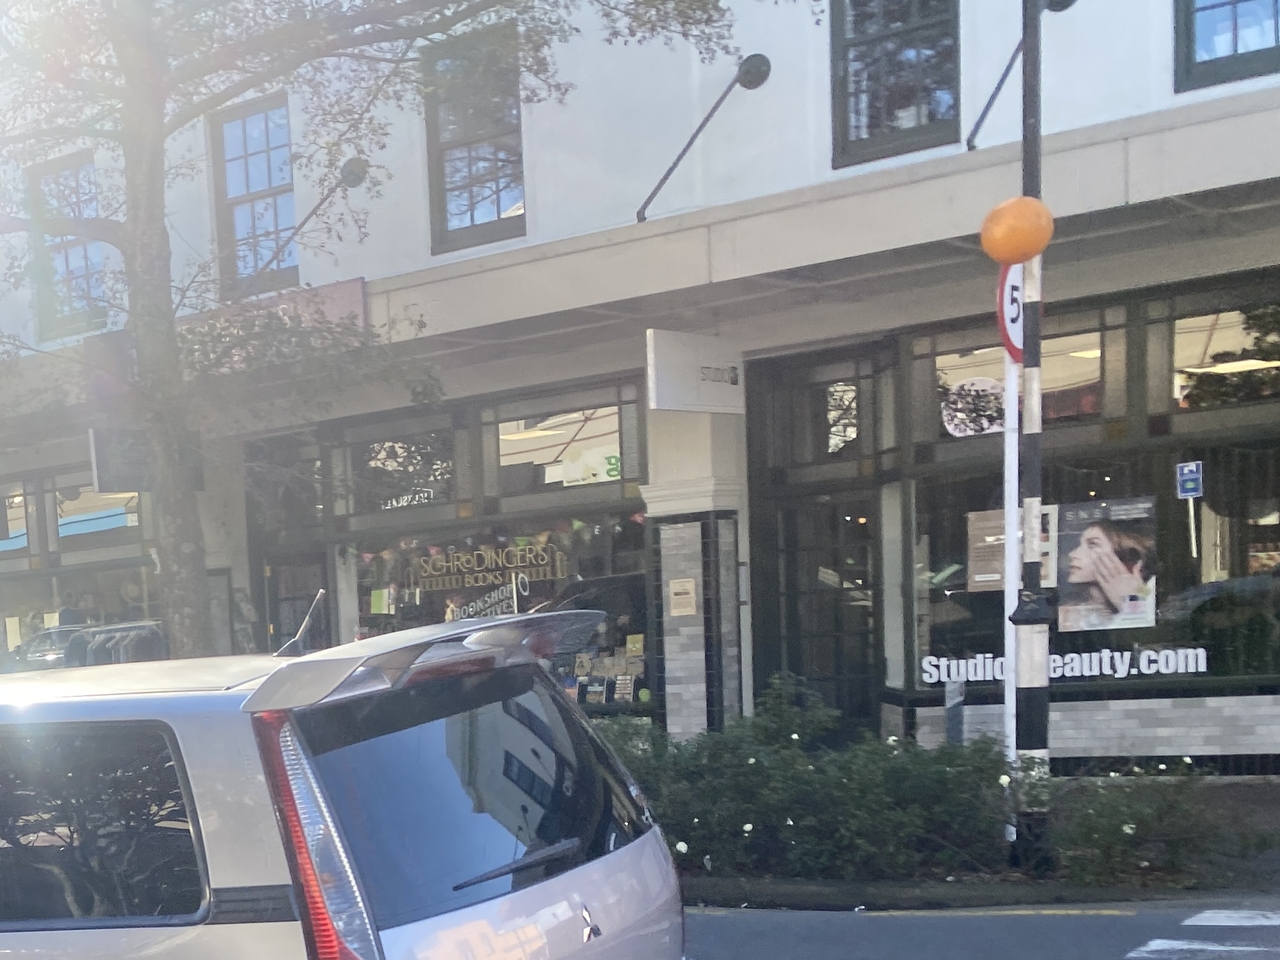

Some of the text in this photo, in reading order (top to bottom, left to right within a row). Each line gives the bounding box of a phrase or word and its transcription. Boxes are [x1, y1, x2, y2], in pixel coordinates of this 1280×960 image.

[1010, 284, 1021, 324] 5
[465, 571, 502, 587] BOOKS
[453, 584, 514, 620] BOOKSHOP
